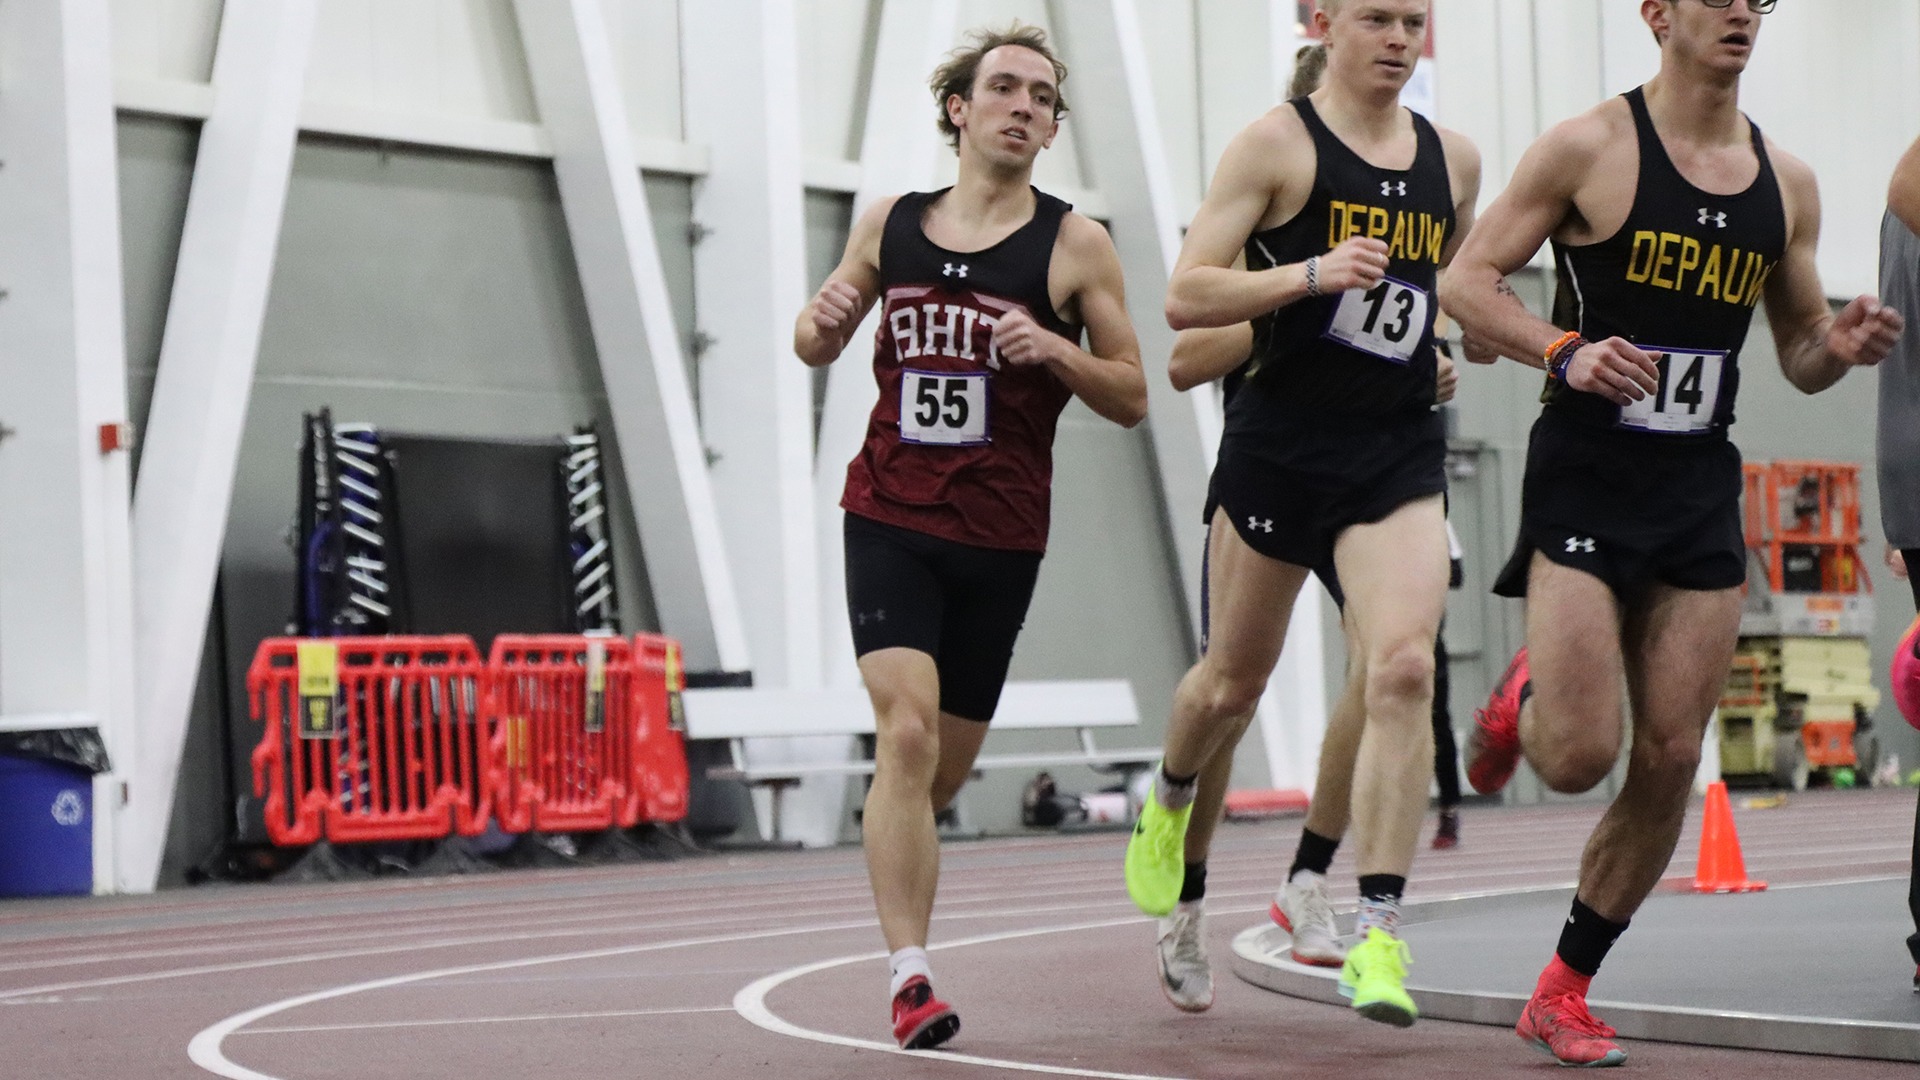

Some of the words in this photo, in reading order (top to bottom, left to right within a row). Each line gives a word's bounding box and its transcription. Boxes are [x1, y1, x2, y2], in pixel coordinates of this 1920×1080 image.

[1328, 201, 1446, 264] DEPAUW
[1626, 231, 1778, 307] DEPAUW
[1362, 281, 1415, 343] 13
[915, 377, 969, 428] 55
[1655, 353, 1704, 414] 14
